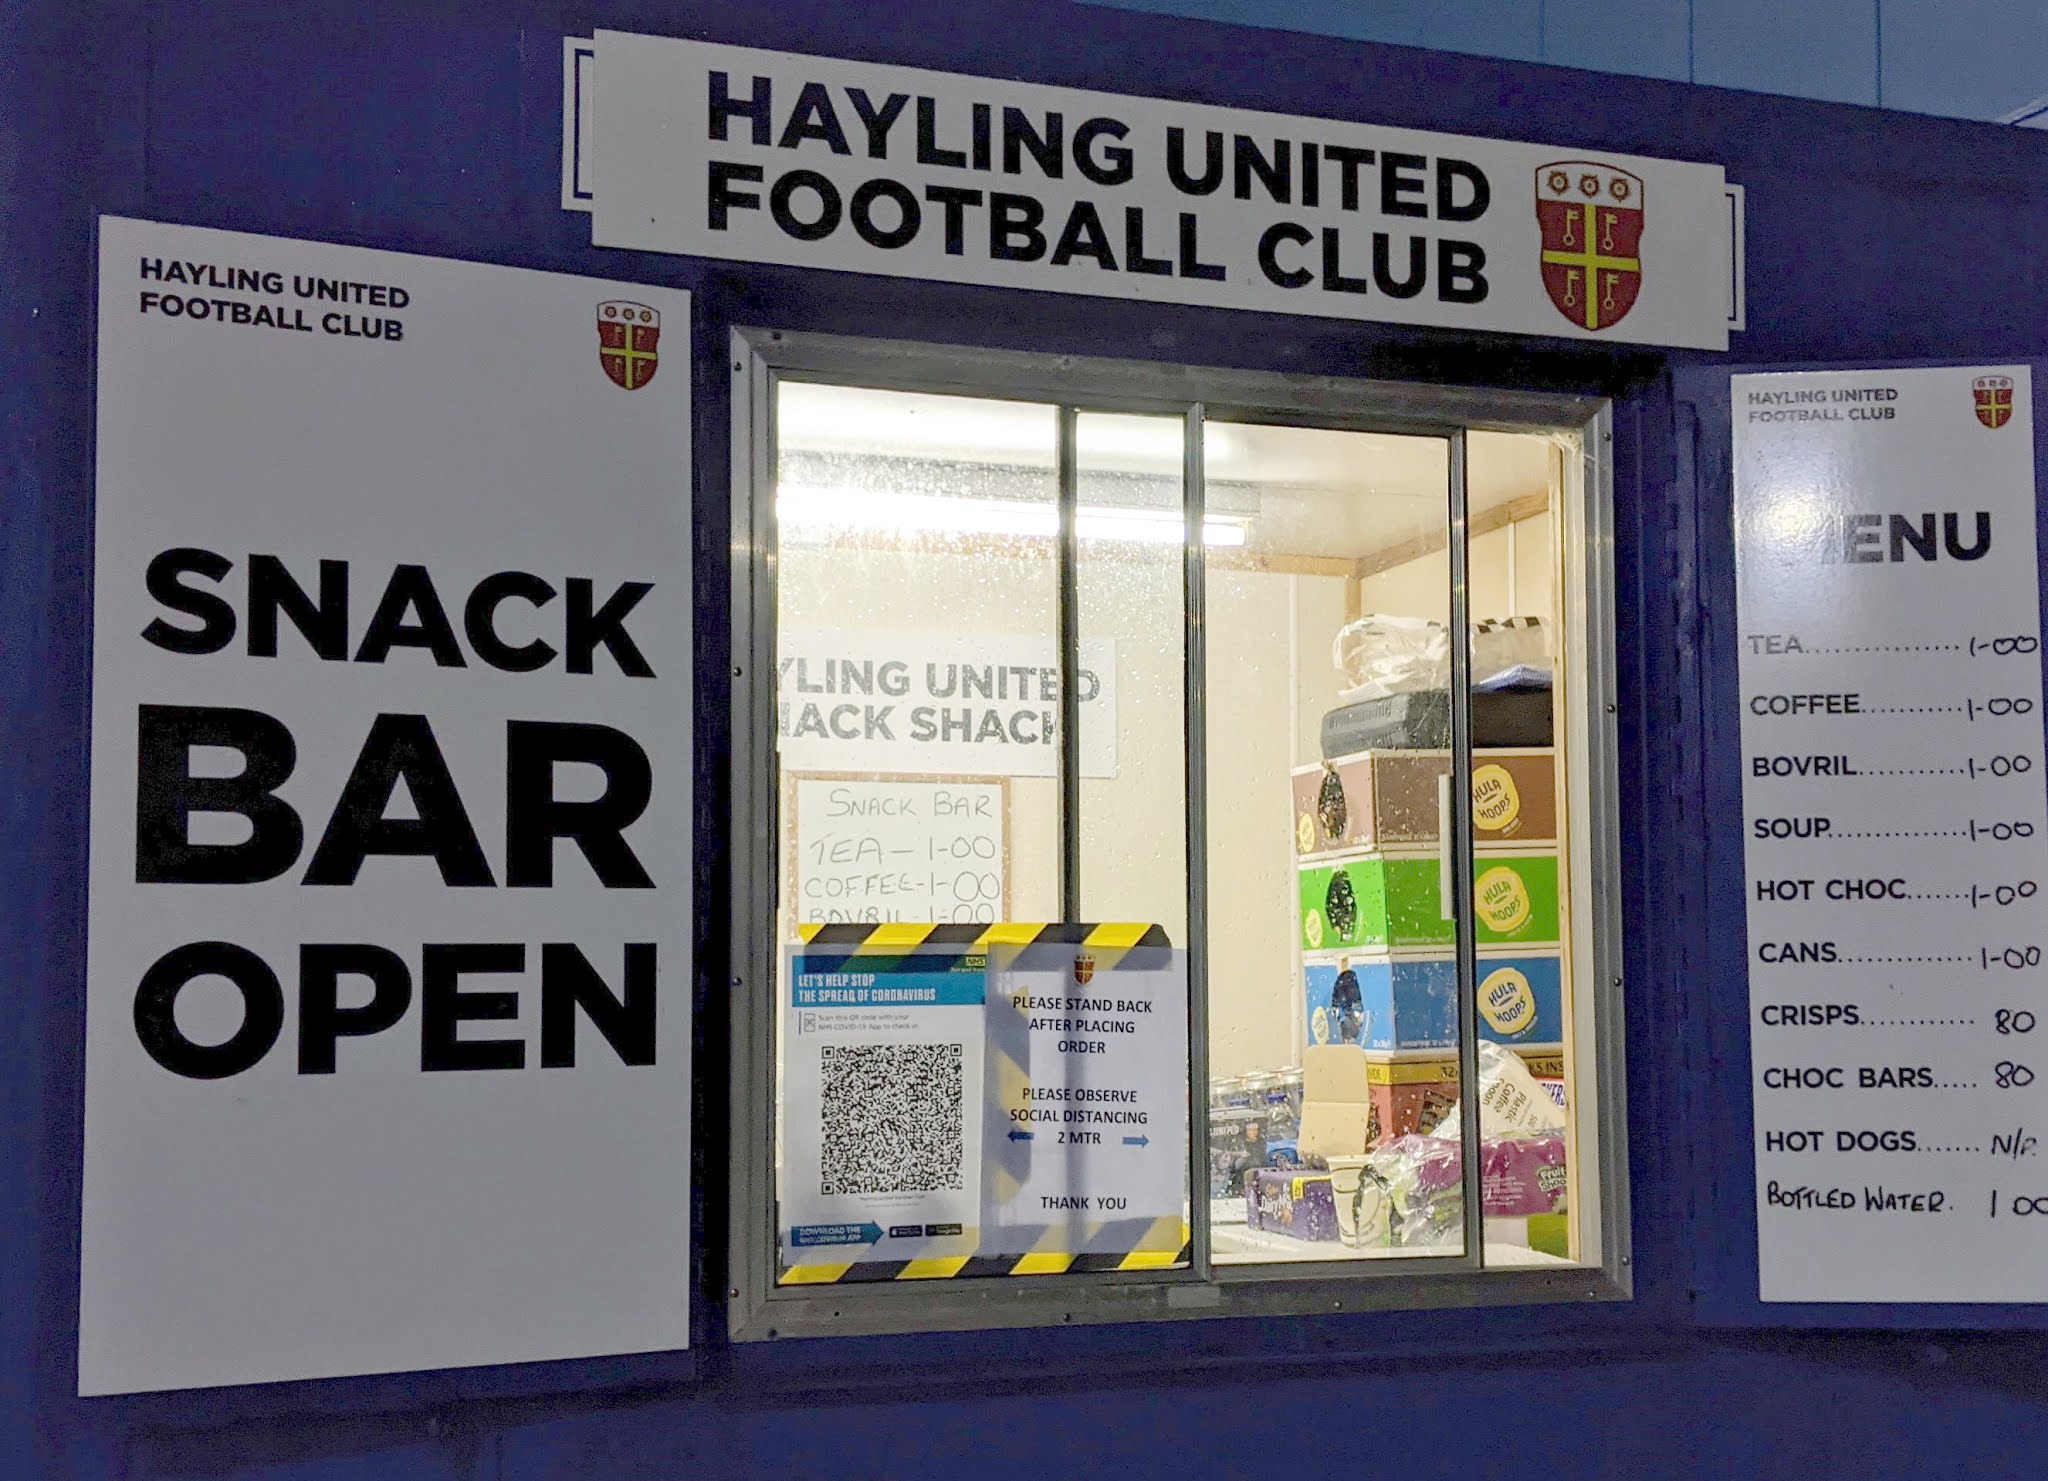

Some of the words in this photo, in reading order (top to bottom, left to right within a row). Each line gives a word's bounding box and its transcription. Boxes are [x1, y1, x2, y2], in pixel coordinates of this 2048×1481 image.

[708, 70, 1134, 186] HAYLING
[1166, 127, 1491, 221] UNITED
[707, 160, 1225, 281] FOOTBALL
[1257, 222, 1489, 305] CLUB
[140, 257, 283, 294] HAYLING
[294, 275, 410, 308] UNITED
[140, 291, 312, 332] FOOTBALL
[322, 312, 404, 341] CLUB
[1748, 390, 1827, 405] HAYLING
[1832, 388, 1898, 402] UNITED
[1749, 408, 1844, 423] FOOTBALL
[1848, 407, 1896, 420] CLUB
[1822, 511, 1991, 564] ENU
[140, 547, 657, 678] SNACK
[926, 663, 1100, 702] UNITED
[1750, 694, 1860, 716] COFFEE
[1752, 756, 1858, 778] BOVRIL
[135, 703, 657, 889] BAR
[825, 788, 917, 817] SNACK
[933, 791, 993, 818] BAR
[1473, 779, 1502, 804] HULA
[1478, 792, 1511, 820] HOOPS
[1754, 818, 1831, 839] SOUP
[809, 833, 884, 866] TEA
[1483, 881, 1512, 906] HULA
[1756, 880, 1815, 901] HOT
[1825, 879, 1907, 901] CHOC
[1488, 894, 1521, 921] HOOPS
[1758, 942, 1838, 963] CANS
[798, 974, 823, 987] LET'S
[826, 974, 848, 986] HELP
[851, 973, 875, 986] STOP
[799, 990, 817, 1002] THE
[818, 989, 855, 1003] SPREAD
[857, 989, 869, 1001] OF
[871, 988, 936, 1001] CORONAVIRUS
[1013, 996, 1062, 1009] PLEASE
[1065, 998, 1113, 1012] STAND
[1117, 1000, 1152, 1013] BACK
[1488, 982, 1517, 1007] HULA
[133, 940, 657, 1080] OPEN
[1493, 995, 1526, 1022] HOOPS
[1761, 1005, 1860, 1026] CRISPS
[1995, 1009, 2036, 1035] 80
[1029, 1018, 1071, 1031] AFTER
[1075, 1019, 1135, 1033] PLACING
[1058, 1040, 1106, 1053] ORDER
[1763, 1068, 1844, 1089] CHOC
[1858, 1067, 1934, 1089] BARS
[1995, 1061, 2035, 1089] 80
[1022, 1088, 1071, 1101] PLEASE
[1075, 1089, 1137, 1103] OBSERVE
[1010, 1109, 1059, 1122] SOCIAL
[1063, 1110, 1148, 1124] DISTANCING
[1058, 1132, 1065, 1144] 2
[1069, 1132, 1101, 1144] MTR
[1766, 1131, 1824, 1152] HOT
[1836, 1131, 1918, 1152] DOGS
[1540, 1178, 1567, 1191] Shoo
[1767, 1180, 1856, 1210] BOTTLED
[1041, 1196, 1089, 1209] THANK
[1097, 1197, 1127, 1210] YOU
